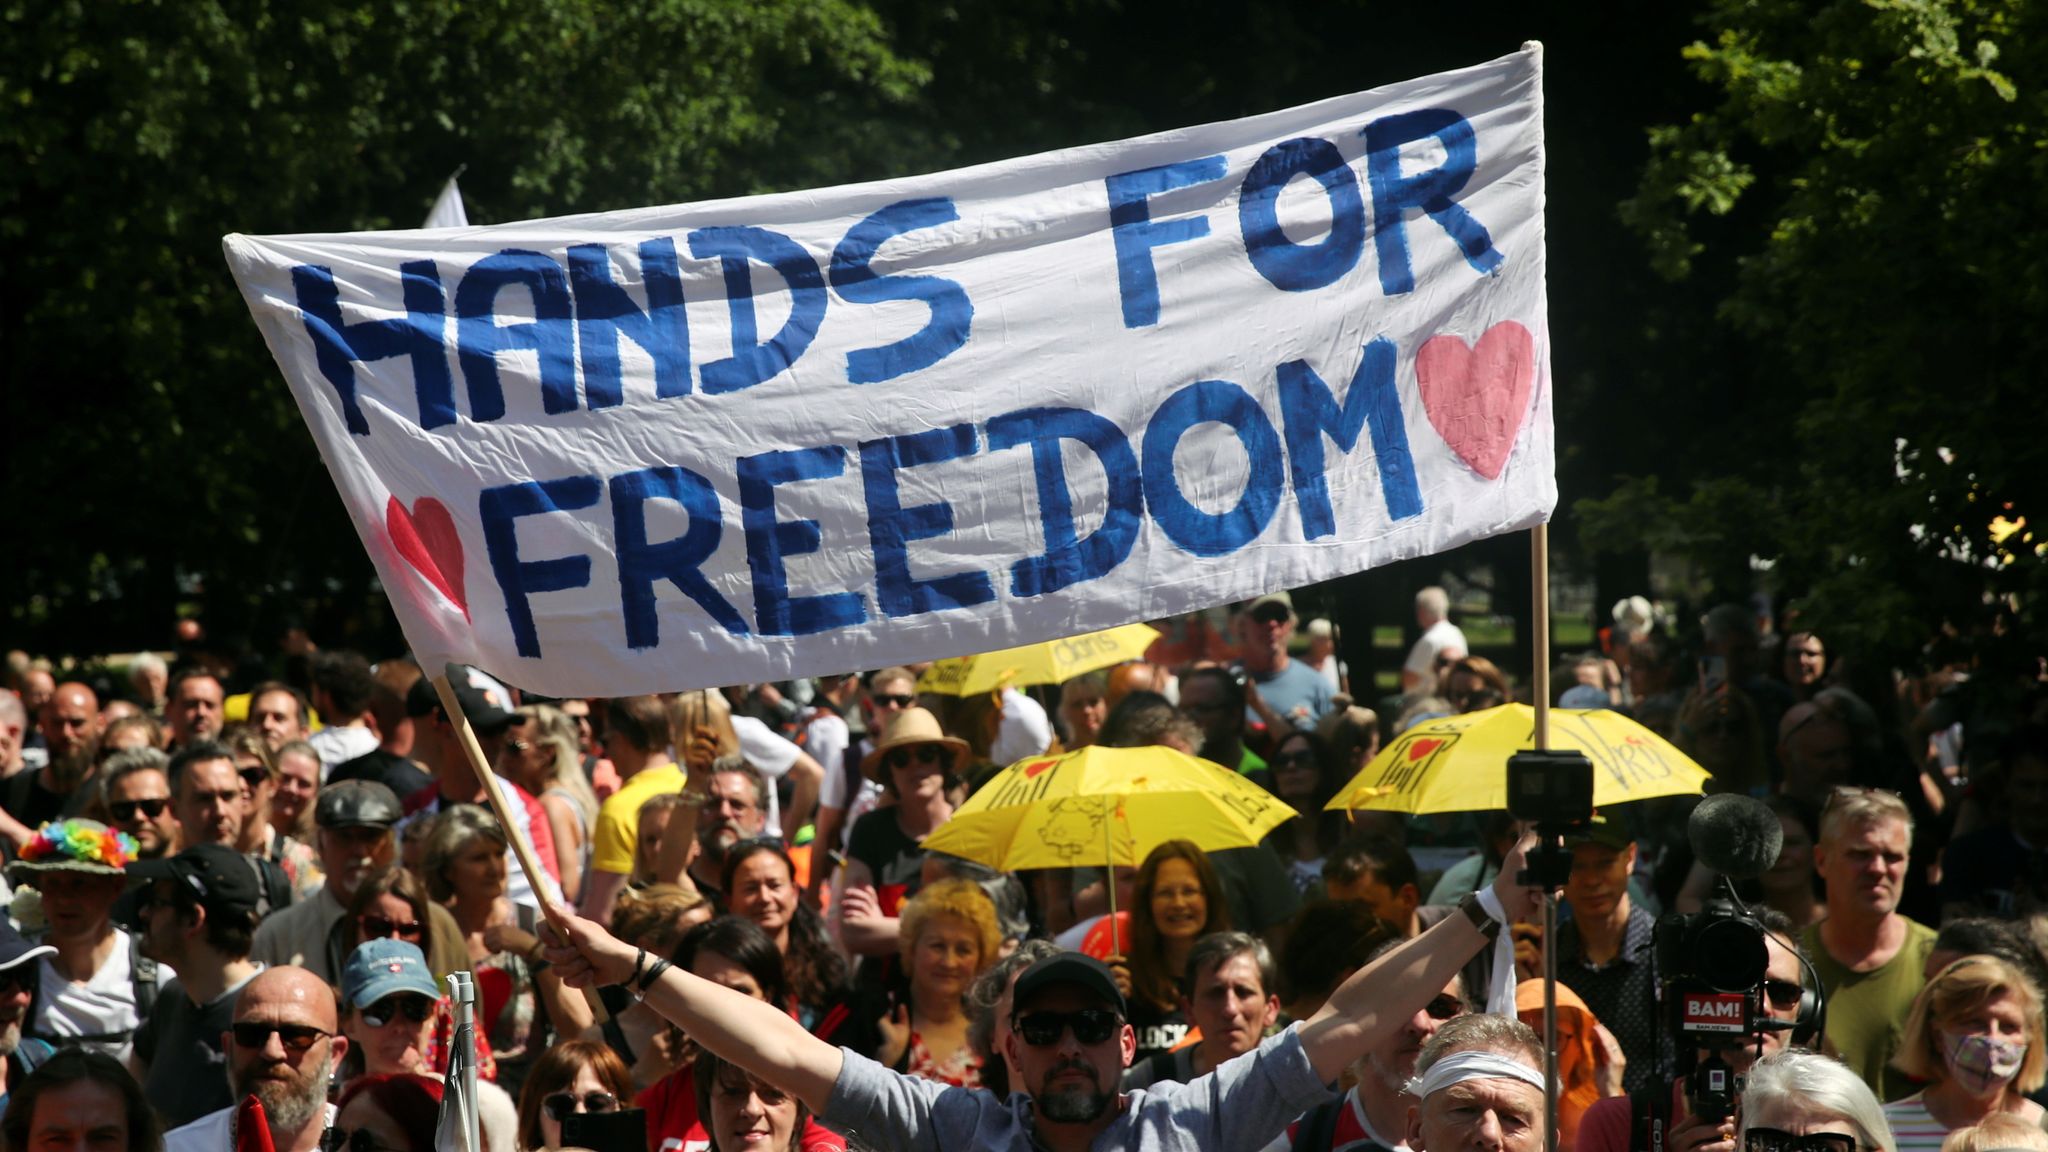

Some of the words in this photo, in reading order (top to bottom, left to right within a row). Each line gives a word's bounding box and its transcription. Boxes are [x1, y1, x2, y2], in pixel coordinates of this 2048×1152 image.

[292, 196, 975, 436] HANDS
[1105, 108, 1505, 328] FOR
[479, 336, 1424, 658] FREEDOM
[1687, 1000, 1740, 1018] BAM!
